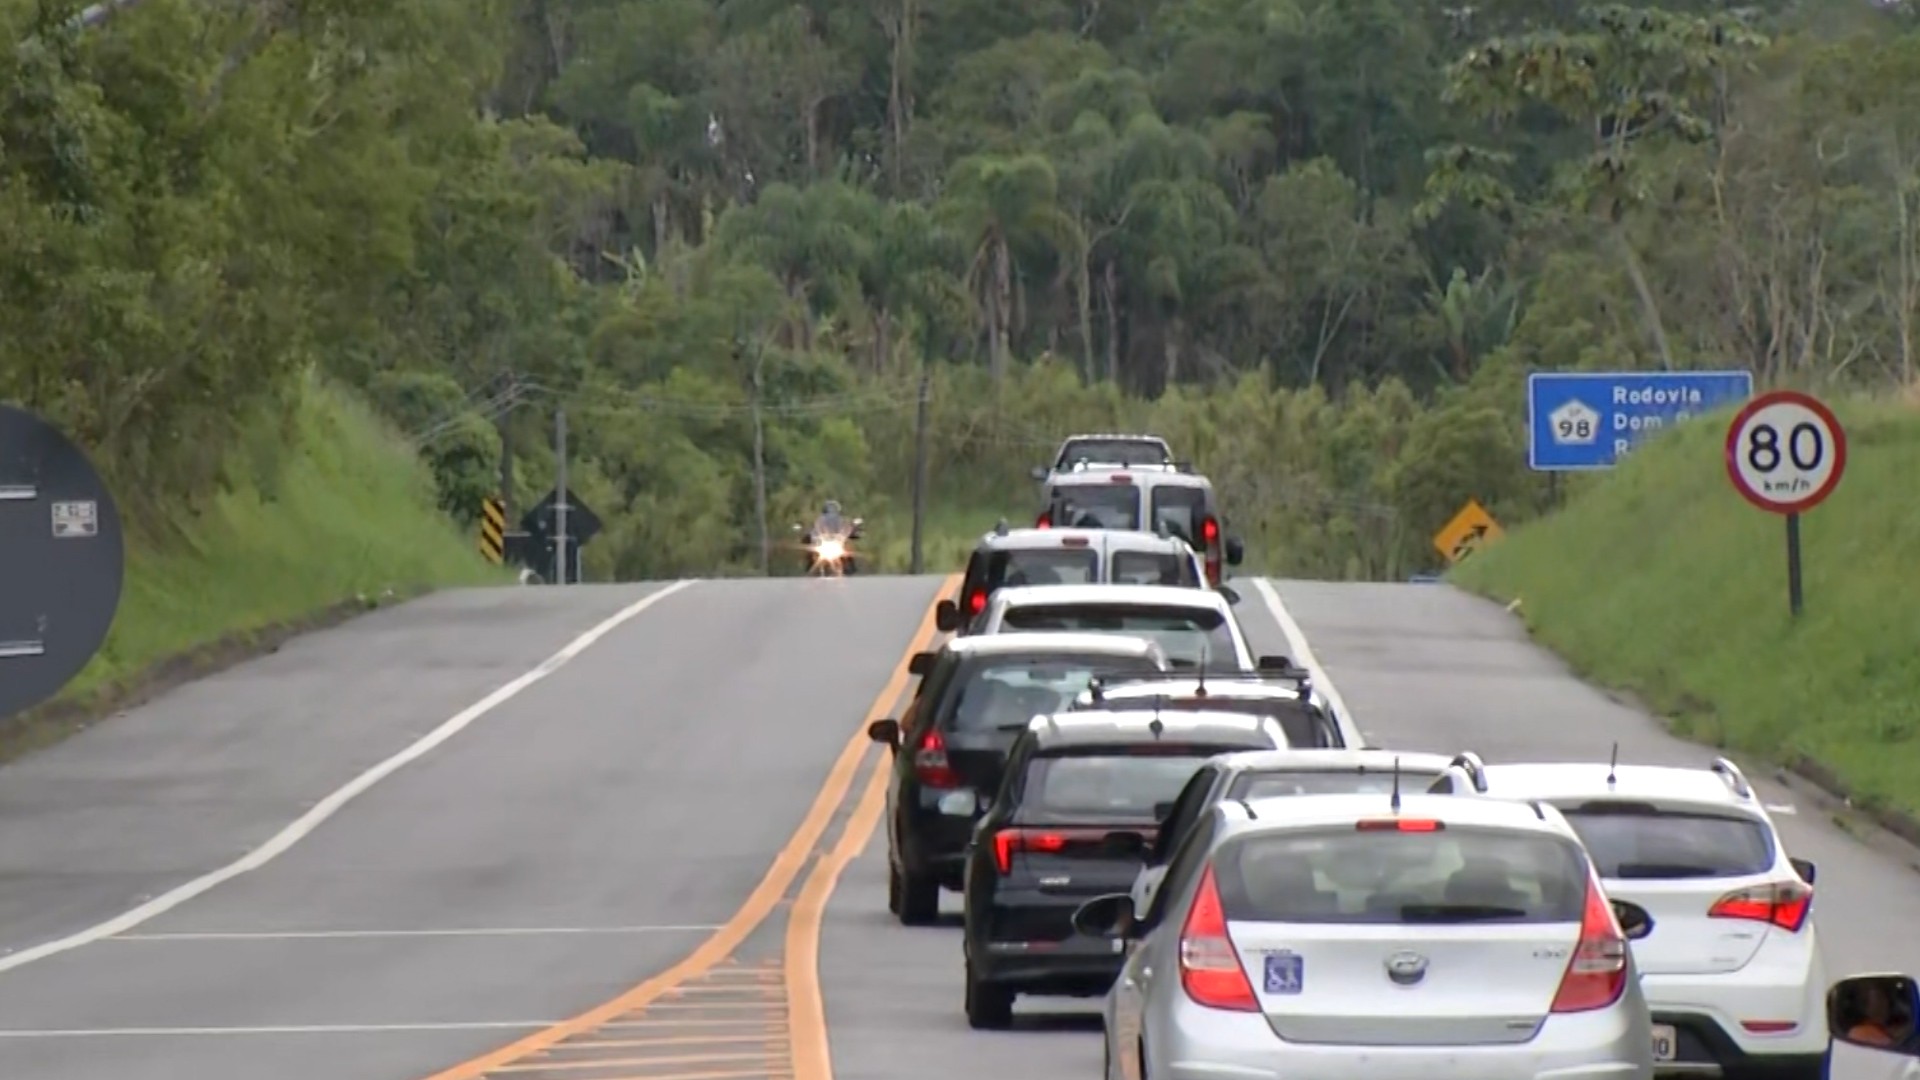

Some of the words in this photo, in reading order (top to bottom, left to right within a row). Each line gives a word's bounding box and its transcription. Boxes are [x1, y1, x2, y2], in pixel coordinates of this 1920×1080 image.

[1613, 386, 1701, 404] Rodovia
[1559, 420, 1590, 438] 98
[1614, 413, 1662, 430] Dom
[1749, 422, 1823, 472] 80
[1764, 479, 1810, 492] km/h
